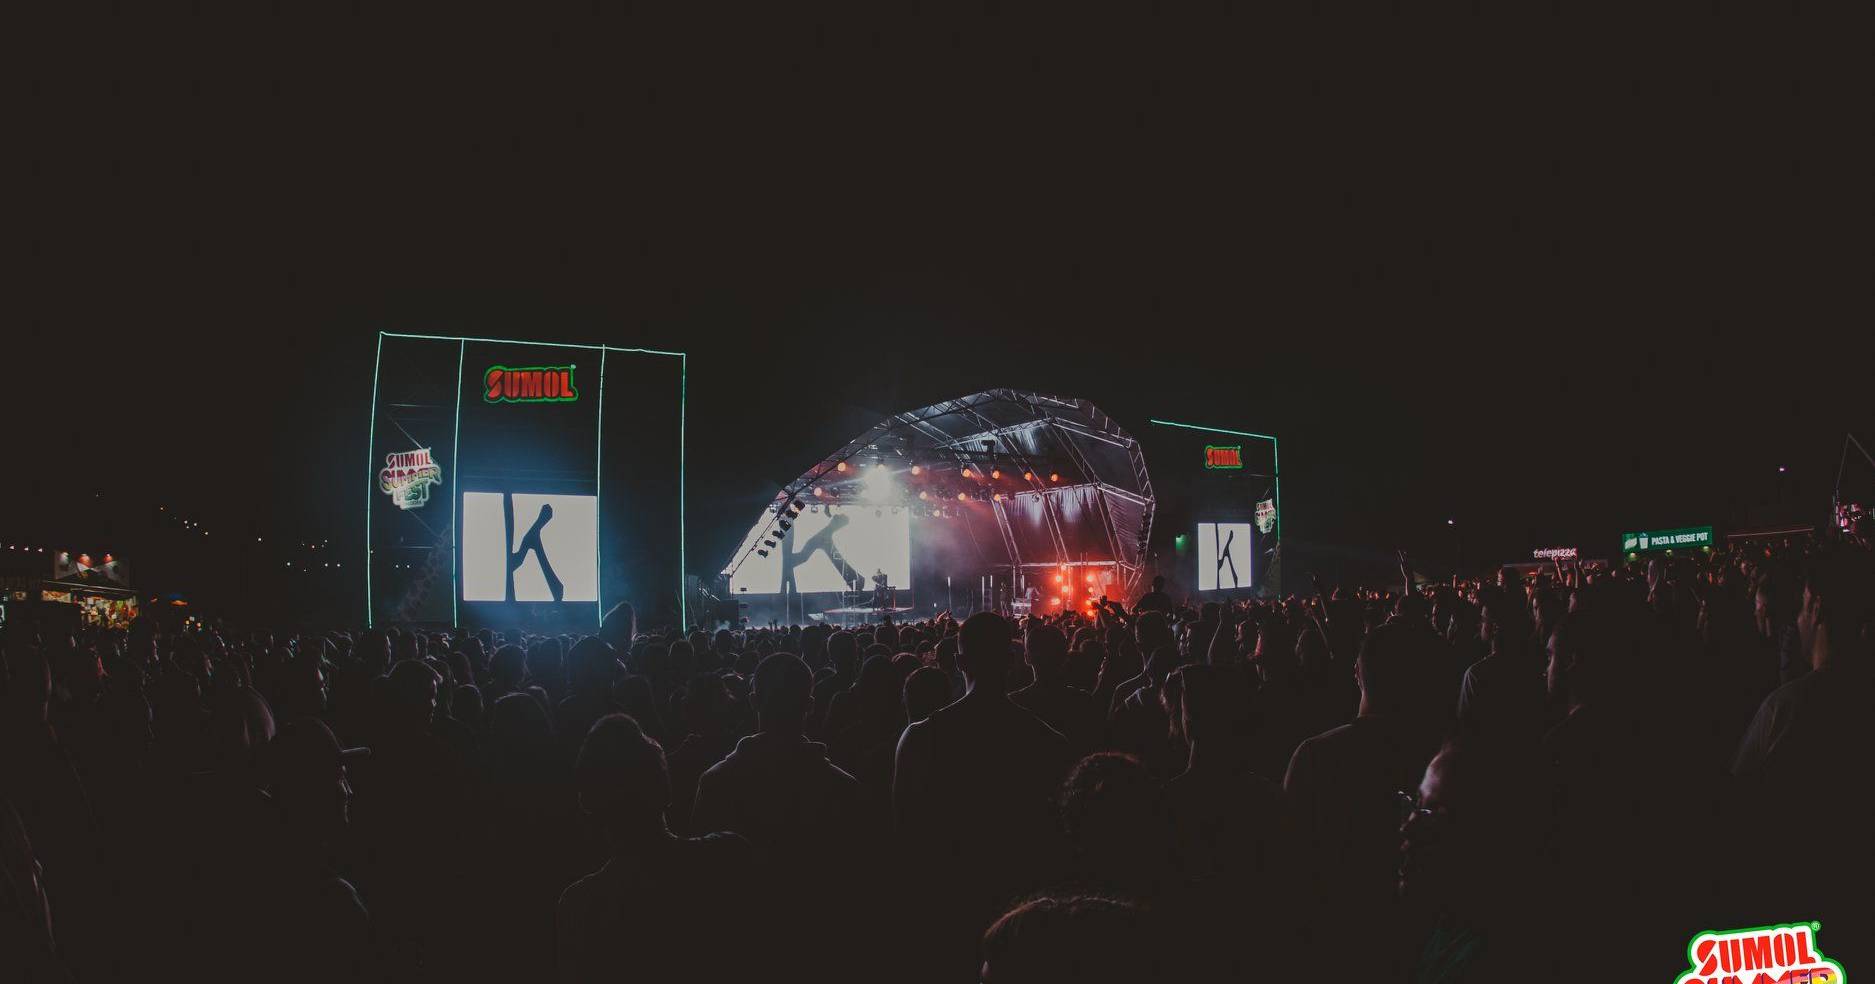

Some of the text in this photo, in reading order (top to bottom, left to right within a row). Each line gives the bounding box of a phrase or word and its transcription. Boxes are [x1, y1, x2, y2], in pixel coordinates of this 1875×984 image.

[487, 370, 574, 399] SUMOL
[388, 452, 431, 469] SUMOL
[503, 492, 564, 602] K
[1651, 536, 1670, 546] PASTA
[1676, 533, 1696, 543] VEGGIE
[1696, 532, 1709, 541] POT
[1215, 523, 1238, 590] K
